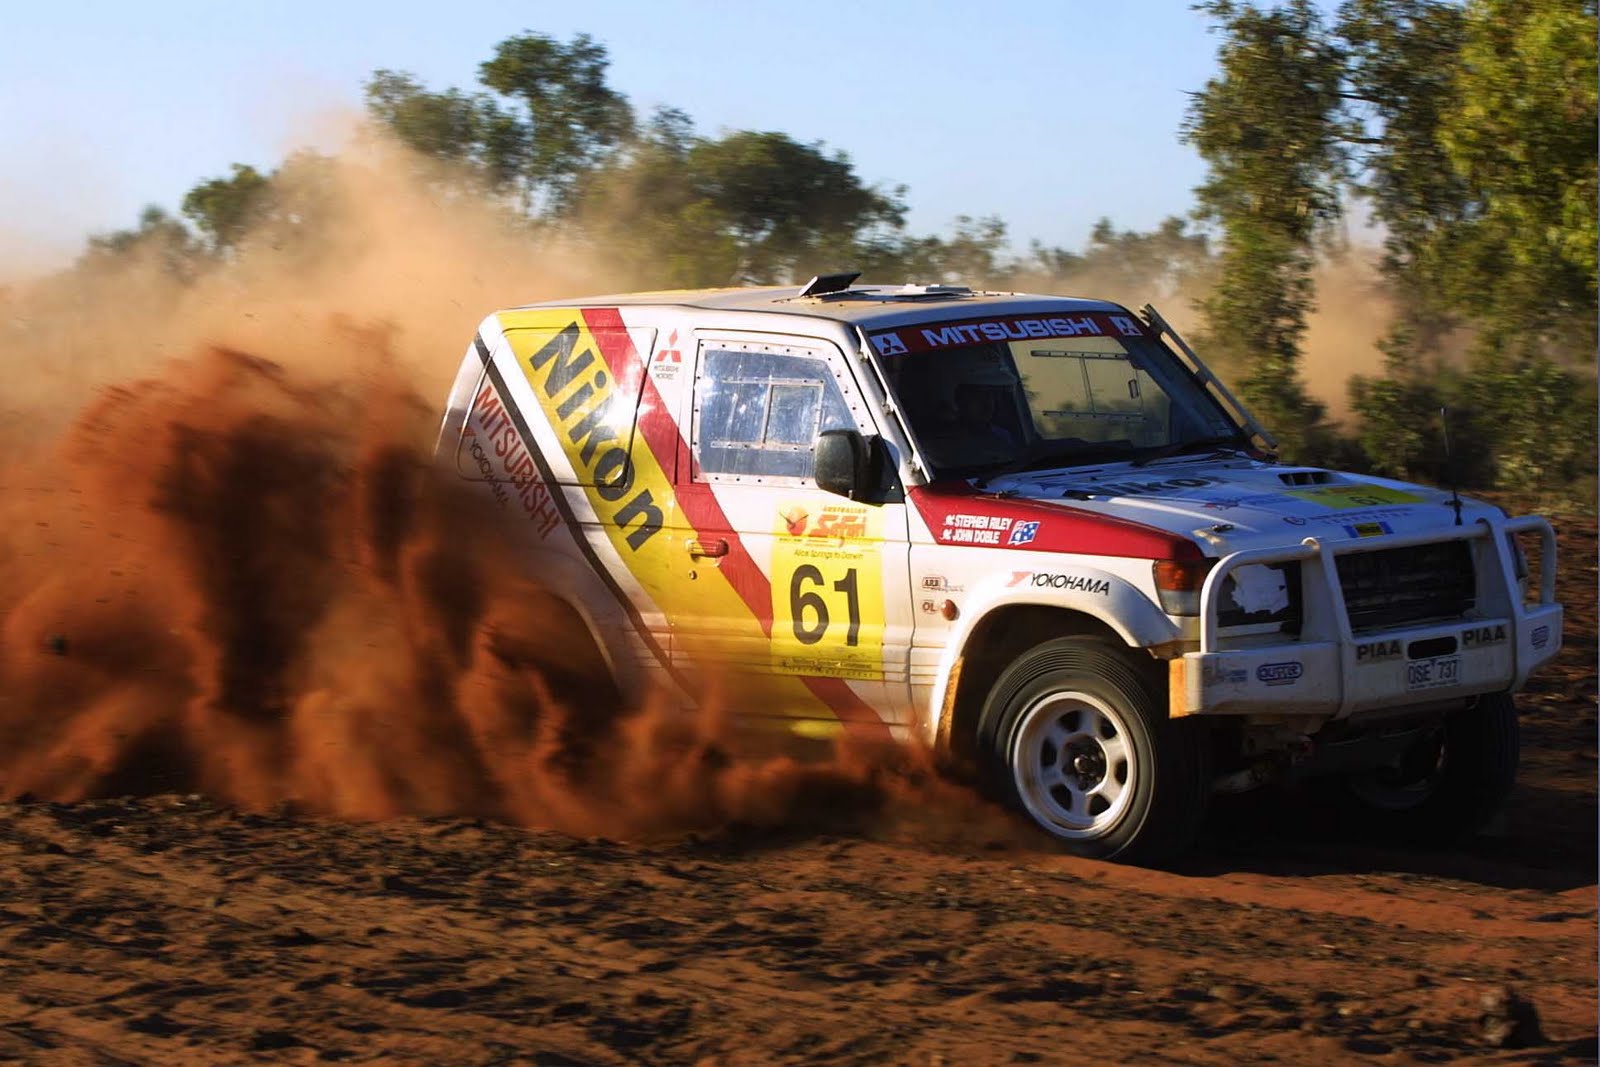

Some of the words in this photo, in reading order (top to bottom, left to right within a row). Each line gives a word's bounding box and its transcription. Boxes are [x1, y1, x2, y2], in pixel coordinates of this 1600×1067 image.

[921, 318, 1101, 346] MITSUBISHI
[529, 321, 664, 552] Nikon
[475, 385, 560, 541] MITSUBISHI
[952, 528, 974, 542] JOHN
[954, 514, 990, 529] STEPHEN
[989, 516, 1013, 531] RILEY
[1030, 572, 1110, 596] YOKOHAMA
[790, 564, 861, 647] 61
[1356, 640, 1403, 661] PIAA
[1461, 624, 1507, 646] PIAA
